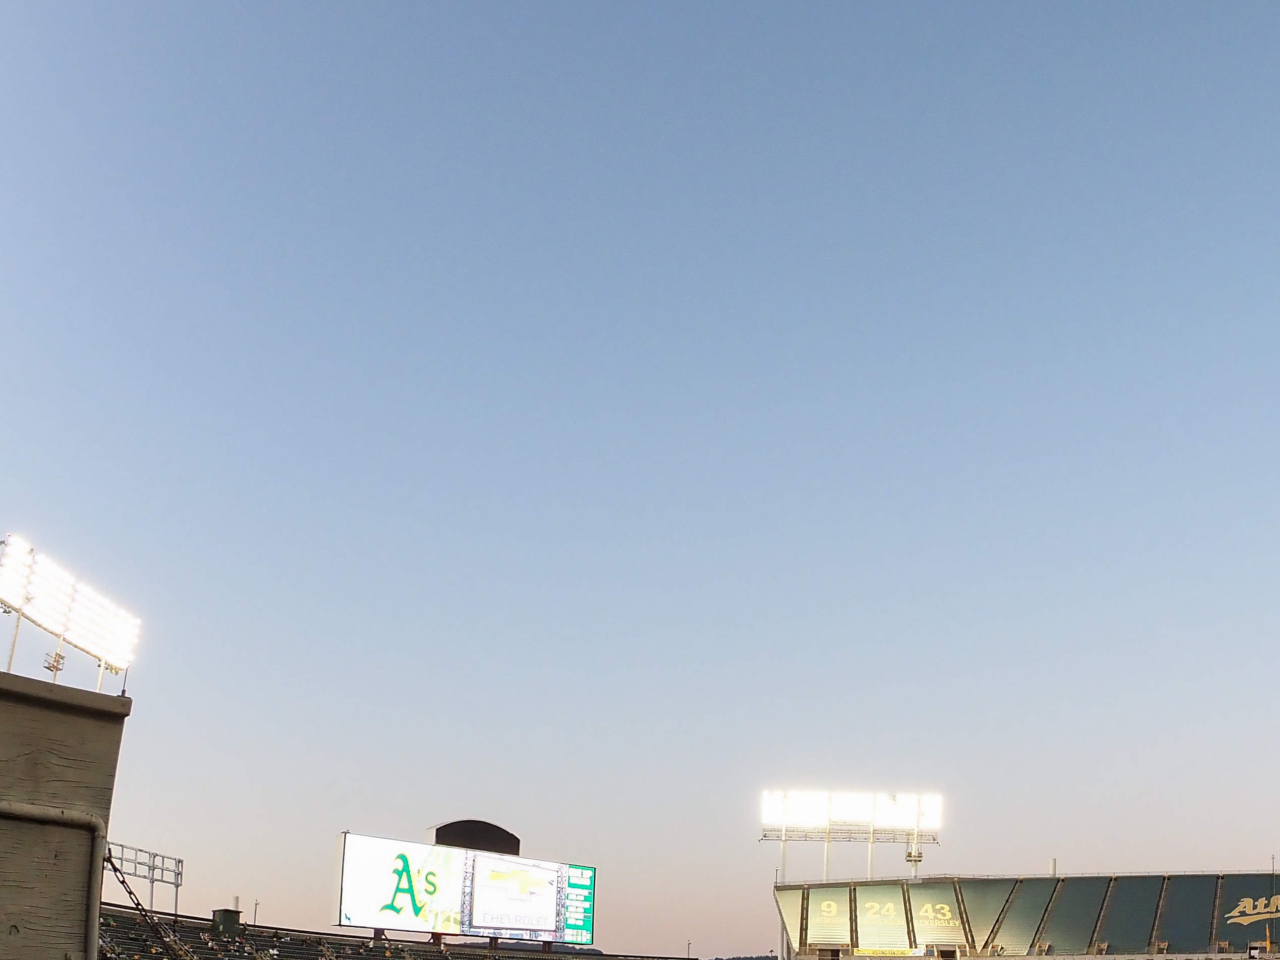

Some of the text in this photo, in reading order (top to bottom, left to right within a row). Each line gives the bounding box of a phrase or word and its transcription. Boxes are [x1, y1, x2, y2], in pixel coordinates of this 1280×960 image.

[379, 853, 438, 917] A's
[821, 900, 838, 917] 9
[864, 902, 897, 918] 24
[919, 903, 952, 920] 43
[914, 919, 960, 927] ECKERSLEY
